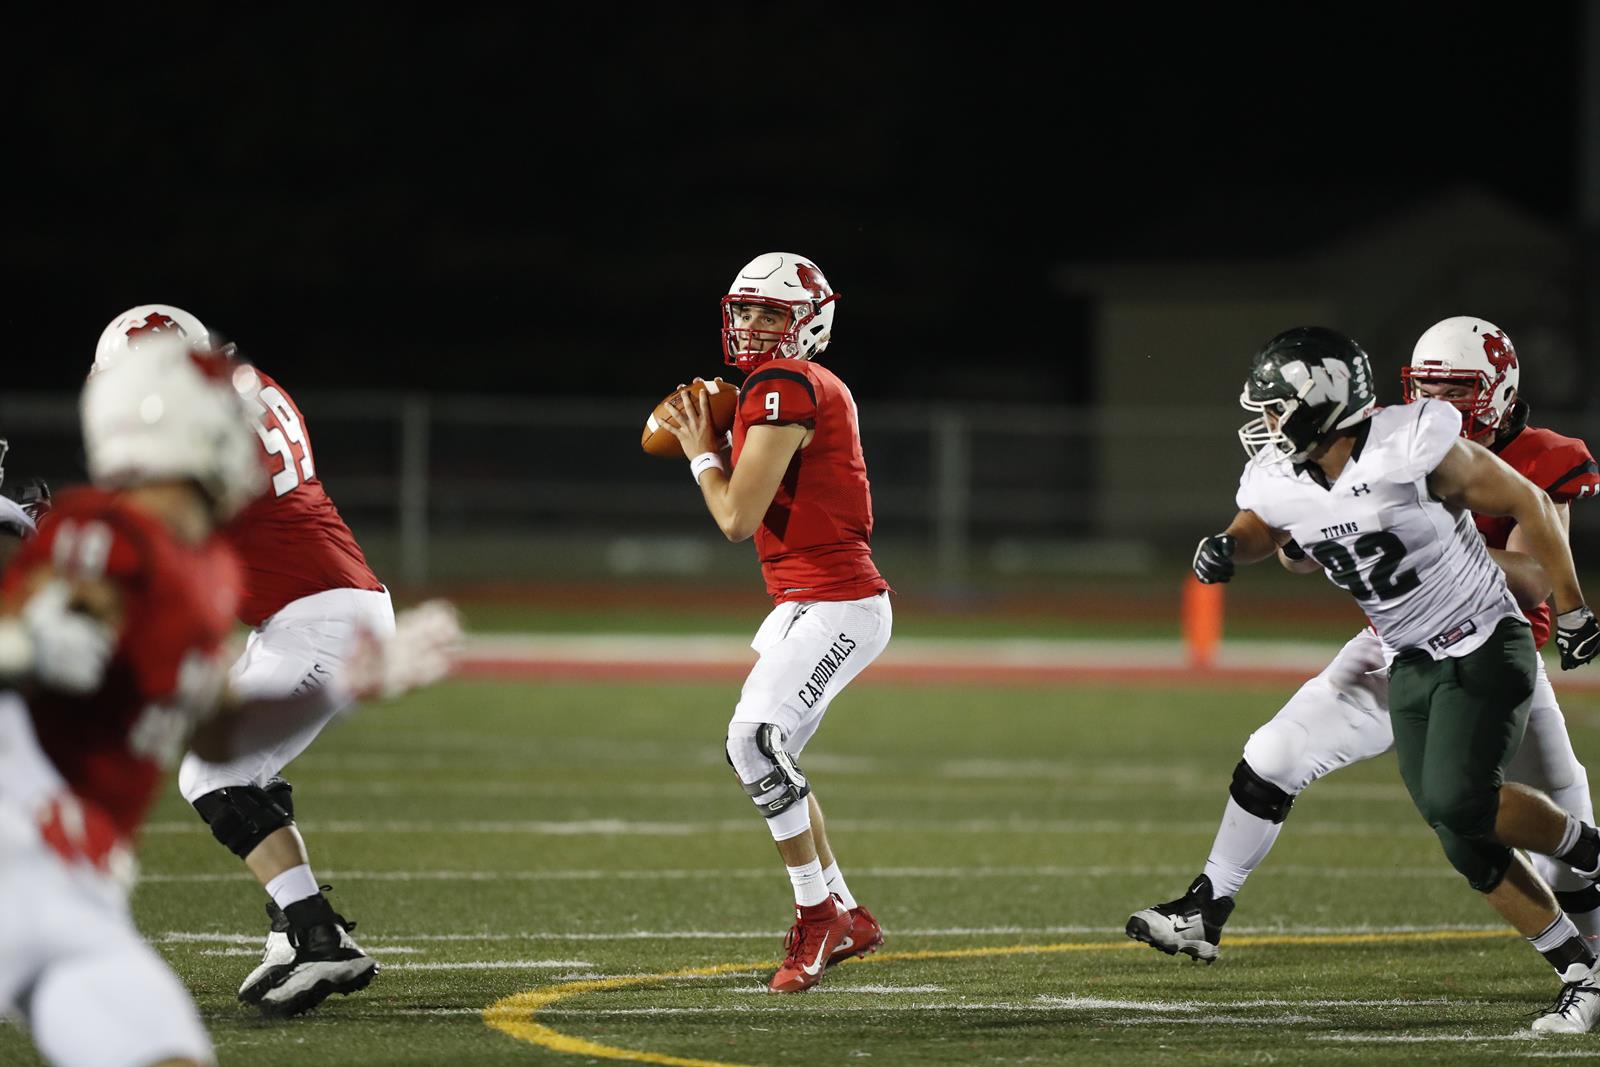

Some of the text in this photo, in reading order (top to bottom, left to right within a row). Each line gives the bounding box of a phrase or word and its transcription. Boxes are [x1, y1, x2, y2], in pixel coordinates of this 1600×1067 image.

[248, 384, 314, 498] 59
[764, 391, 780, 421] 9
[1312, 530, 1422, 602] 92
[1320, 521, 1360, 539] TITANS
[798, 632, 857, 709] CARDINALS
